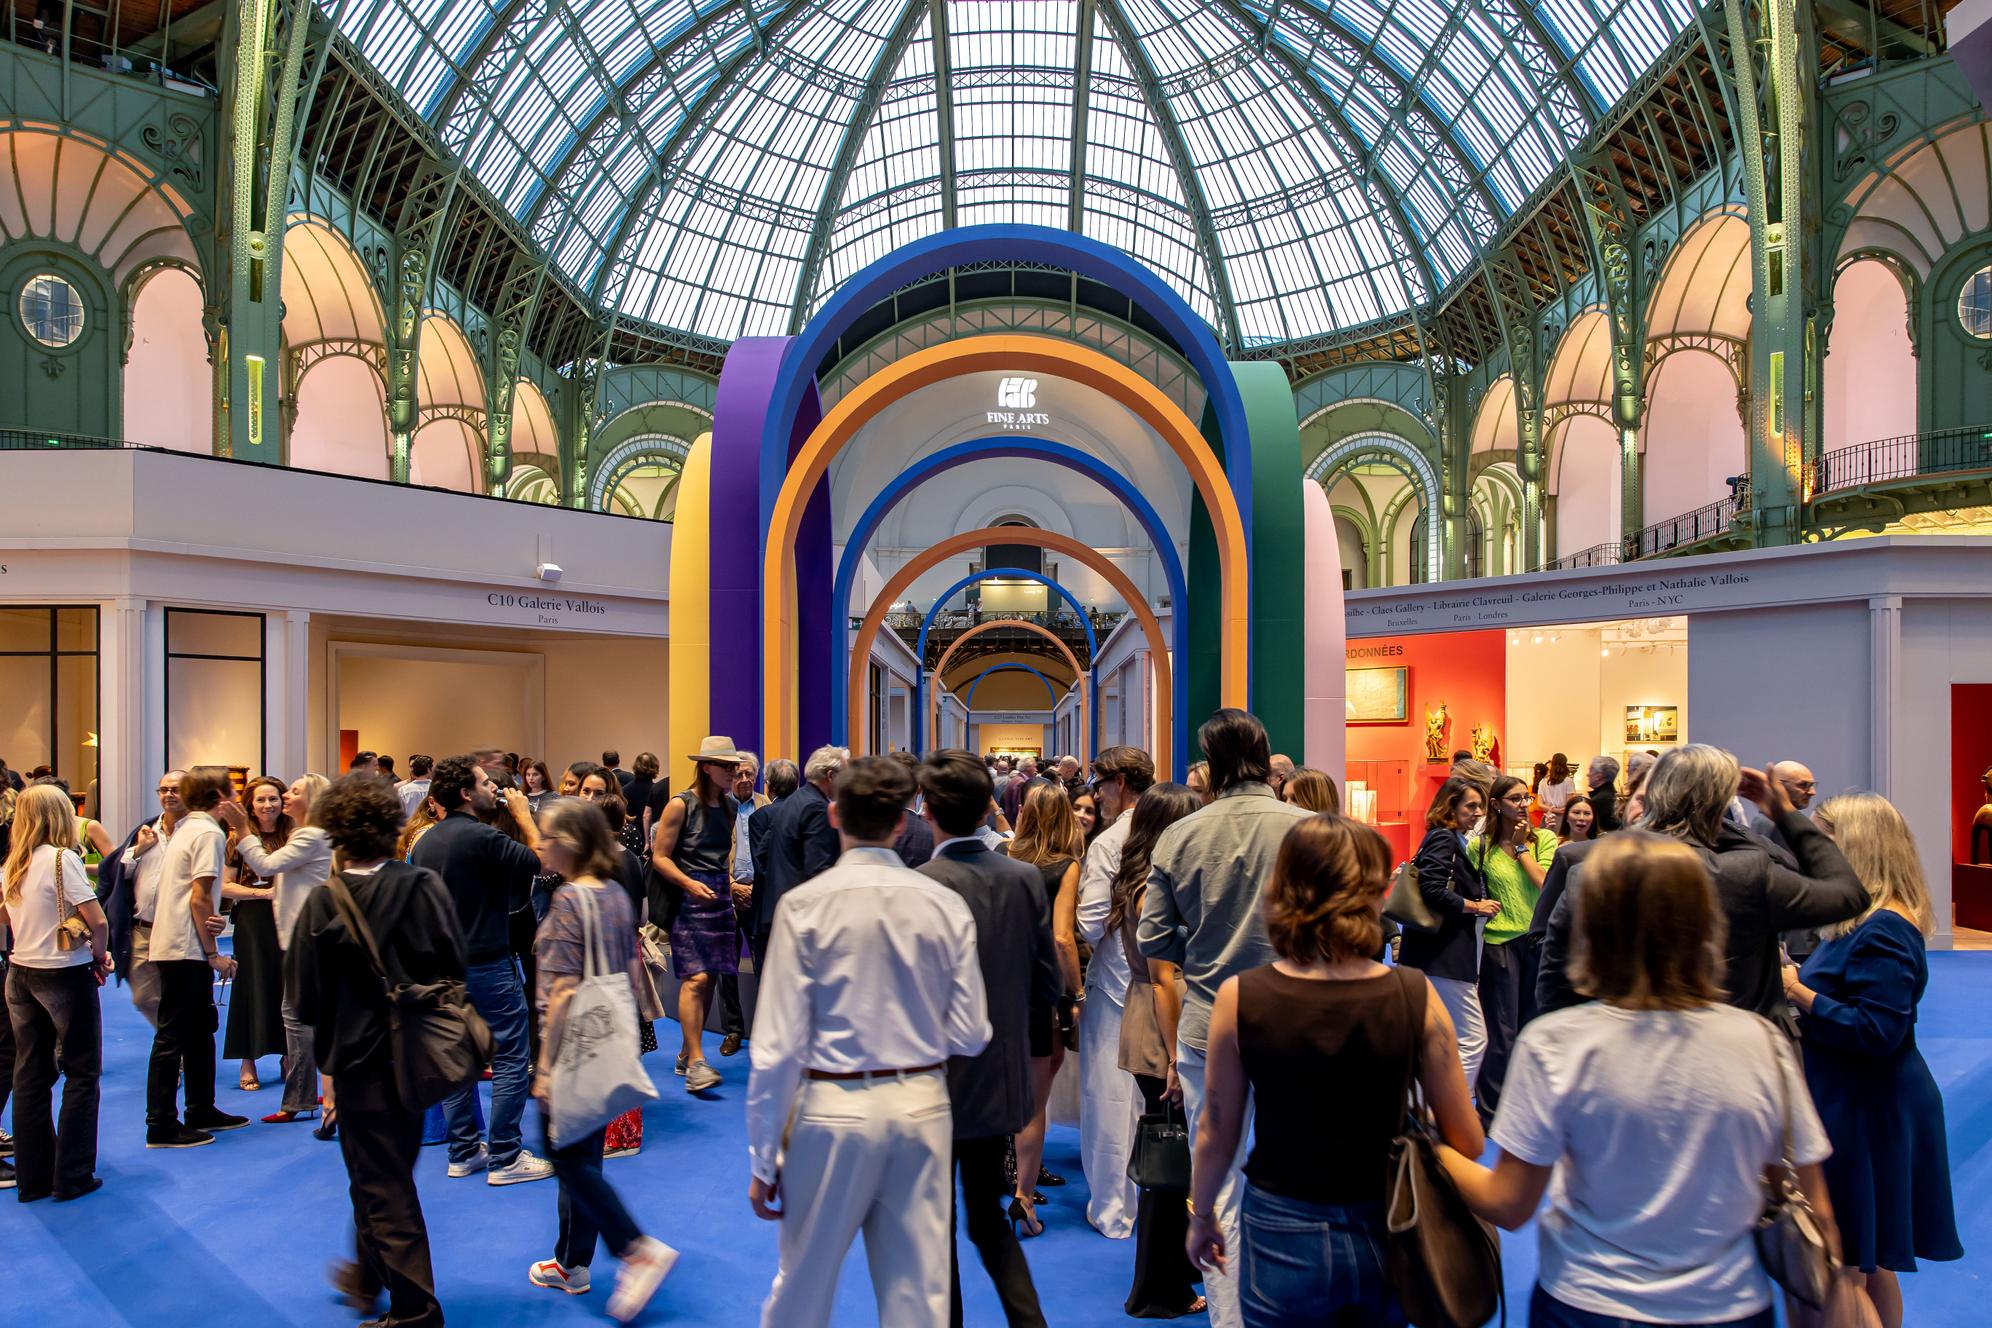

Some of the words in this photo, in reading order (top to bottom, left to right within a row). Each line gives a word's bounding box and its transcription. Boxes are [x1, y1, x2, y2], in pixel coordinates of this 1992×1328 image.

[987, 412, 1015, 423] FINE
[1017, 413, 1050, 425] ARTS
[1371, 606, 1393, 615] Claes
[1395, 603, 1425, 614] Gallery
[1433, 599, 1469, 610] Librairie
[1472, 594, 1513, 607] Clavreuil
[1522, 591, 1556, 603] Galerie
[1558, 583, 1646, 599] Georges-Philippe
[1646, 583, 1656, 591] et
[1659, 576, 1707, 590] Nathalie
[1709, 573, 1749, 586] Vallois
[487, 593, 514, 607] C10
[518, 595, 562, 611] Galerie
[565, 598, 605, 615] Vallois
[1628, 599, 1650, 608] Paris
[1657, 595, 1683, 606] NYC
[538, 614, 559, 625] Paris
[1387, 617, 1418, 627] Bruxelles
[1453, 613, 1471, 622] Paris
[1478, 610, 1508, 620] Londres
